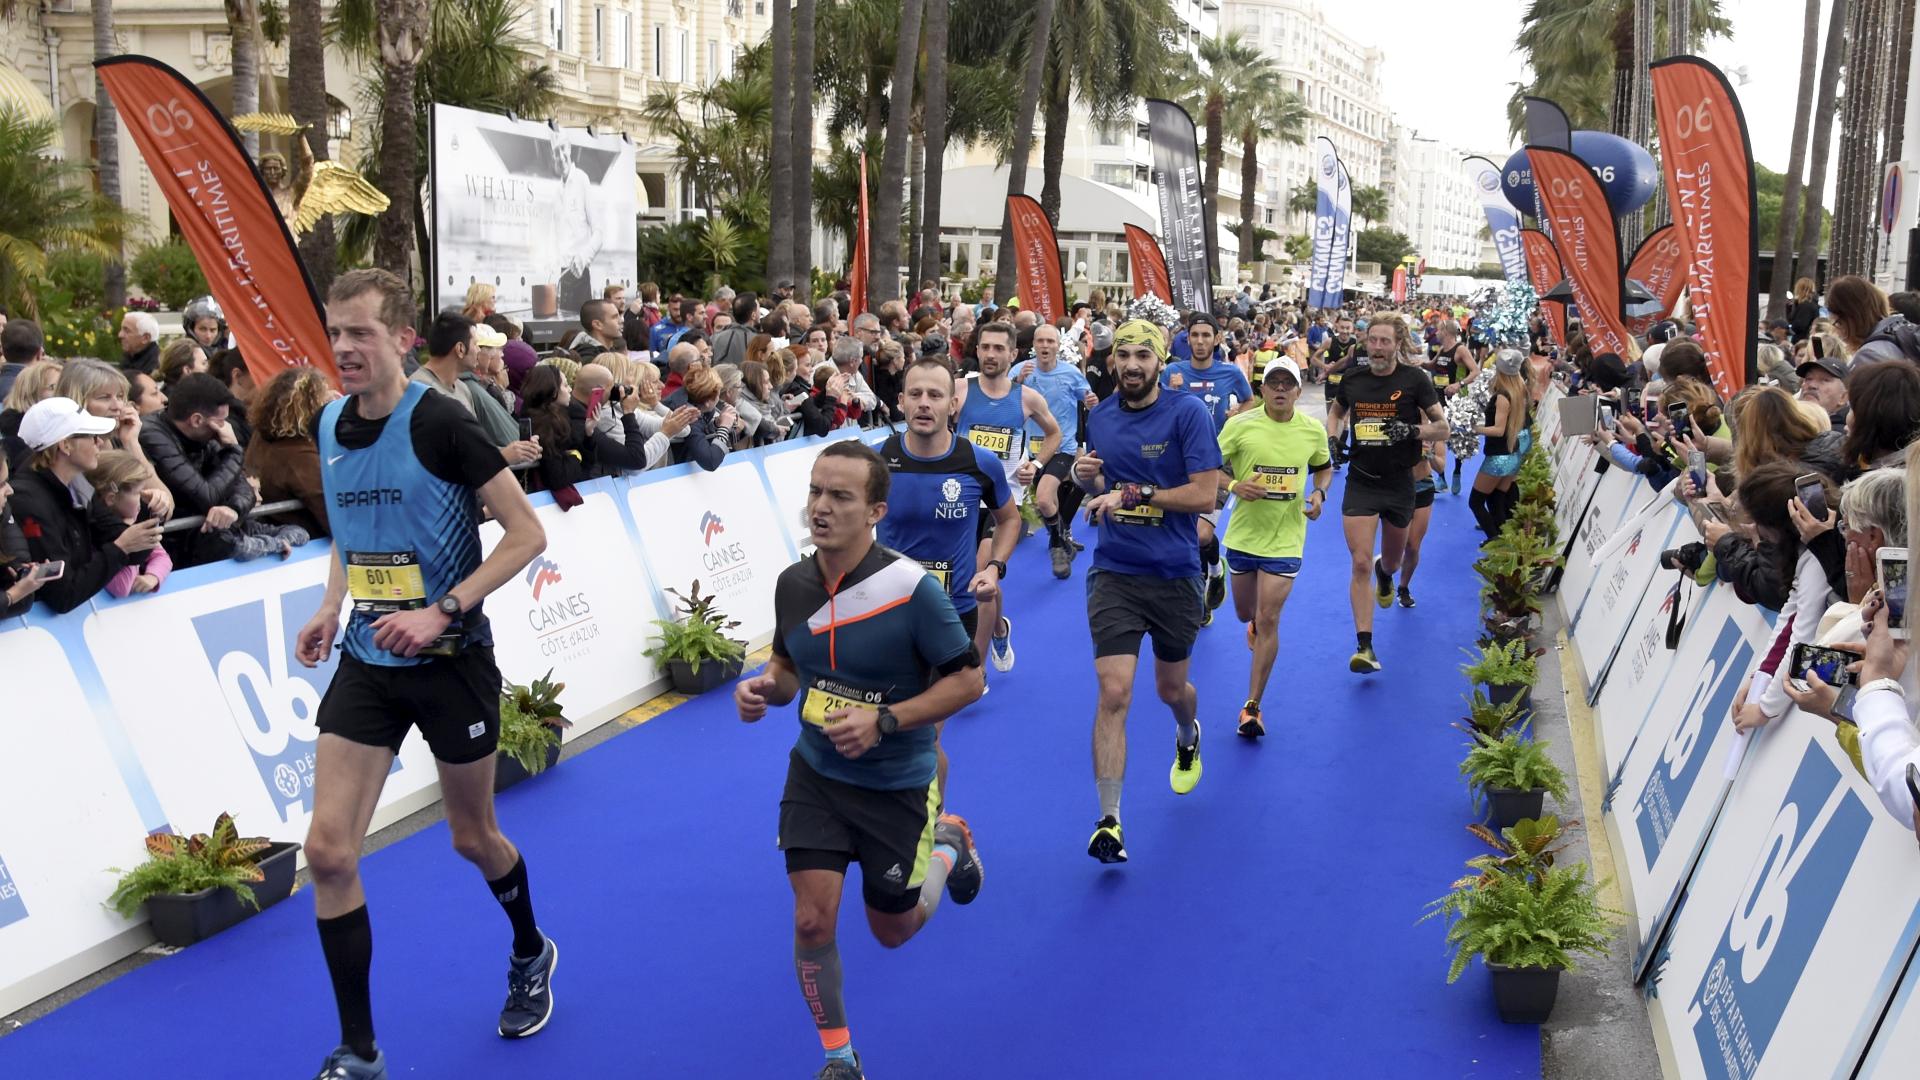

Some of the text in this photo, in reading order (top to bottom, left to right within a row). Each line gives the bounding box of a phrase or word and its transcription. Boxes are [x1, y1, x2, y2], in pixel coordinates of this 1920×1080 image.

[146, 97, 194, 138] 06
[1676, 97, 1713, 140] 06
[465, 174, 535, 203] WHAT'S
[1551, 177, 1584, 199] 06
[1656, 239, 1680, 256] 06
[975, 434, 1005, 449] 6278
[1265, 474, 1283, 485] 984
[336, 488, 404, 508] SPARTA
[935, 506, 968, 519] NICE
[391, 553, 410, 565] 06
[702, 541, 746, 571] CANNES
[935, 561, 948, 570] 06
[366, 568, 393, 585] 601
[528, 592, 590, 631] CANNES
[541, 635, 568, 657] CÔTE
[217, 630, 323, 757] 06
[865, 691, 882, 704] 06
